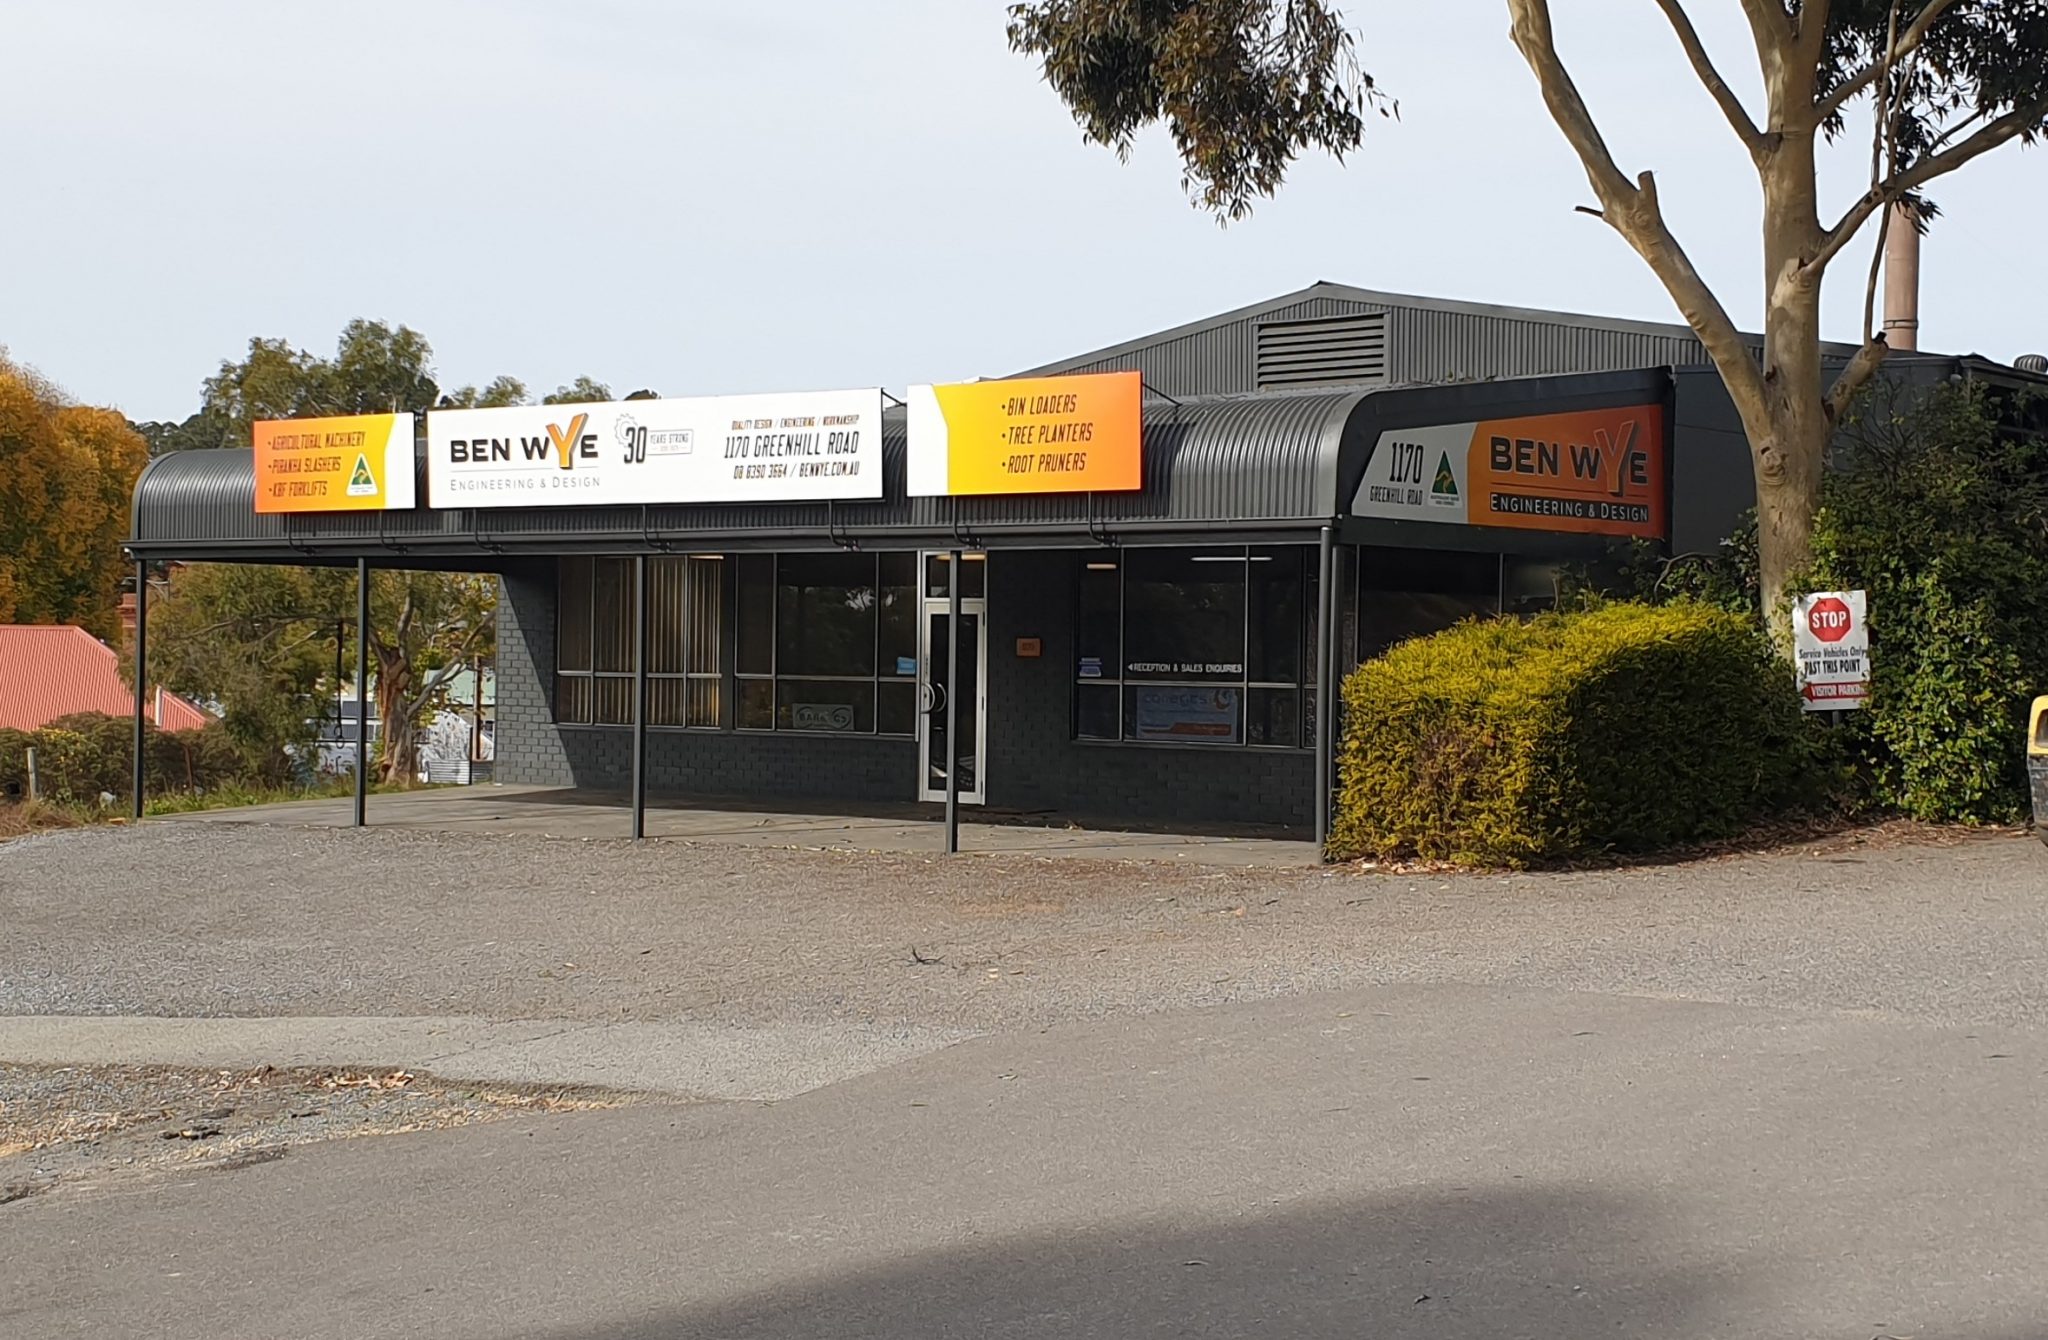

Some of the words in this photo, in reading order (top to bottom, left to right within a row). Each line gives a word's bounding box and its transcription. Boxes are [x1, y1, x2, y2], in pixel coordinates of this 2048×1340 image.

[1008, 397, 1026, 416] BIN
[1030, 394, 1077, 415] LOADERS
[324, 432, 366, 448] MACHINERY
[650, 434, 667, 444] YEARS
[669, 433, 688, 444] STRONG
[1008, 426, 1035, 444] TREE
[1038, 423, 1094, 444] PLANTERS
[450, 438, 510, 462] BEN
[624, 426, 647, 464] 30
[724, 435, 749, 459] 1170
[754, 432, 821, 458] GREENHILL
[828, 431, 860, 454] ROAD
[1008, 454, 1035, 474] ROOT
[1038, 452, 1087, 472] PRUNERS
[1389, 442, 1424, 484] 1170
[1489, 434, 1560, 478] BEN
[734, 465, 744, 479] 08
[768, 464, 786, 478] 3664
[289, 481, 328, 496] FORKLIFTS
[540, 478, 546, 488] &
[1370, 486, 1404, 504] GREENHILL
[1407, 489, 1423, 506] ROAD
[1588, 504, 1595, 518] &
[1812, 611, 1847, 628] STOP
[1798, 648, 1822, 659] Service
[1824, 647, 1848, 658] Vehicles
[1134, 662, 1170, 672] RECEPTION
[1172, 664, 1178, 672] &
[1182, 664, 1202, 672] SALES
[1206, 664, 1242, 673] ENQUIRIES
[1804, 661, 1821, 676] PAST
[1822, 660, 1838, 674] THIS
[1840, 658, 1860, 672] POINT
